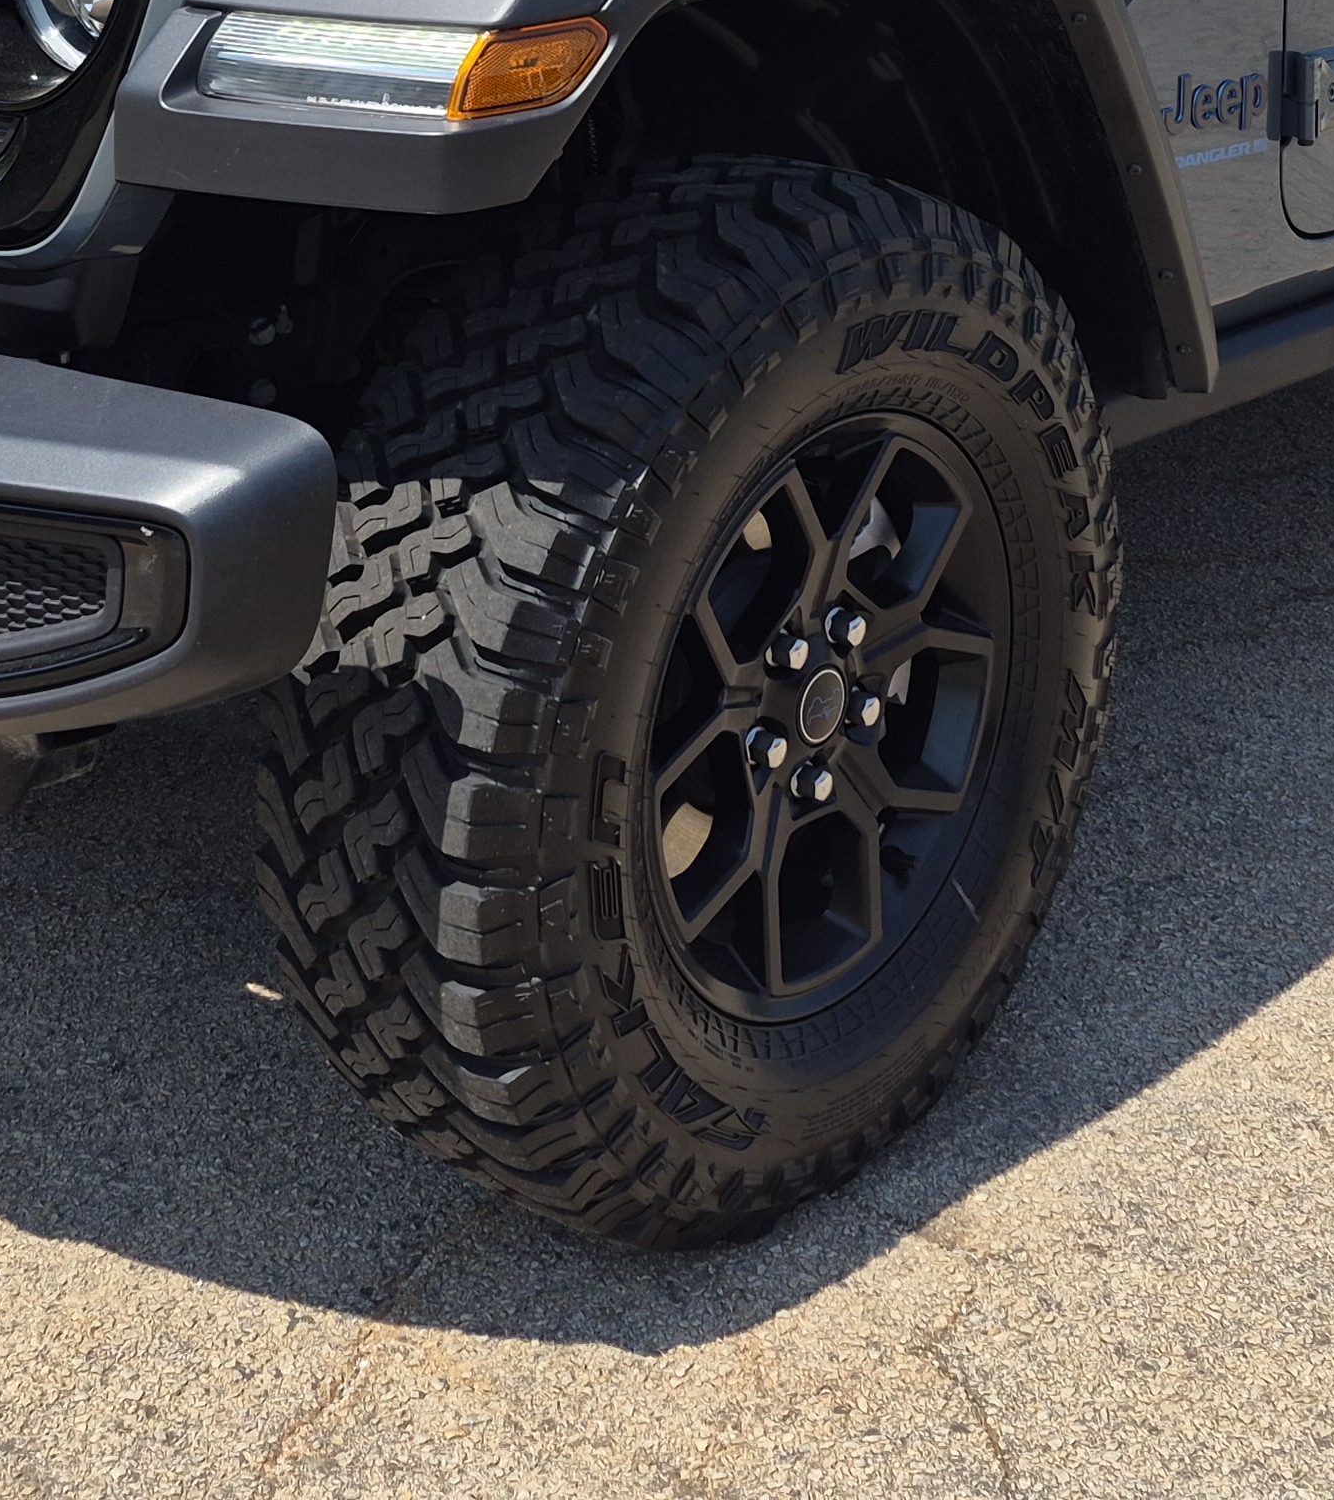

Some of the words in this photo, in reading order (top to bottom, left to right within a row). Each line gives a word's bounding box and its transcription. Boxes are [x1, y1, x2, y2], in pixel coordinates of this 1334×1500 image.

[1161, 73, 1267, 136] Jeep
[1174, 142, 1251, 169] RANGLER
[835, 309, 1097, 617] WILDPEAK
[590, 750, 769, 1152] FALKEN
